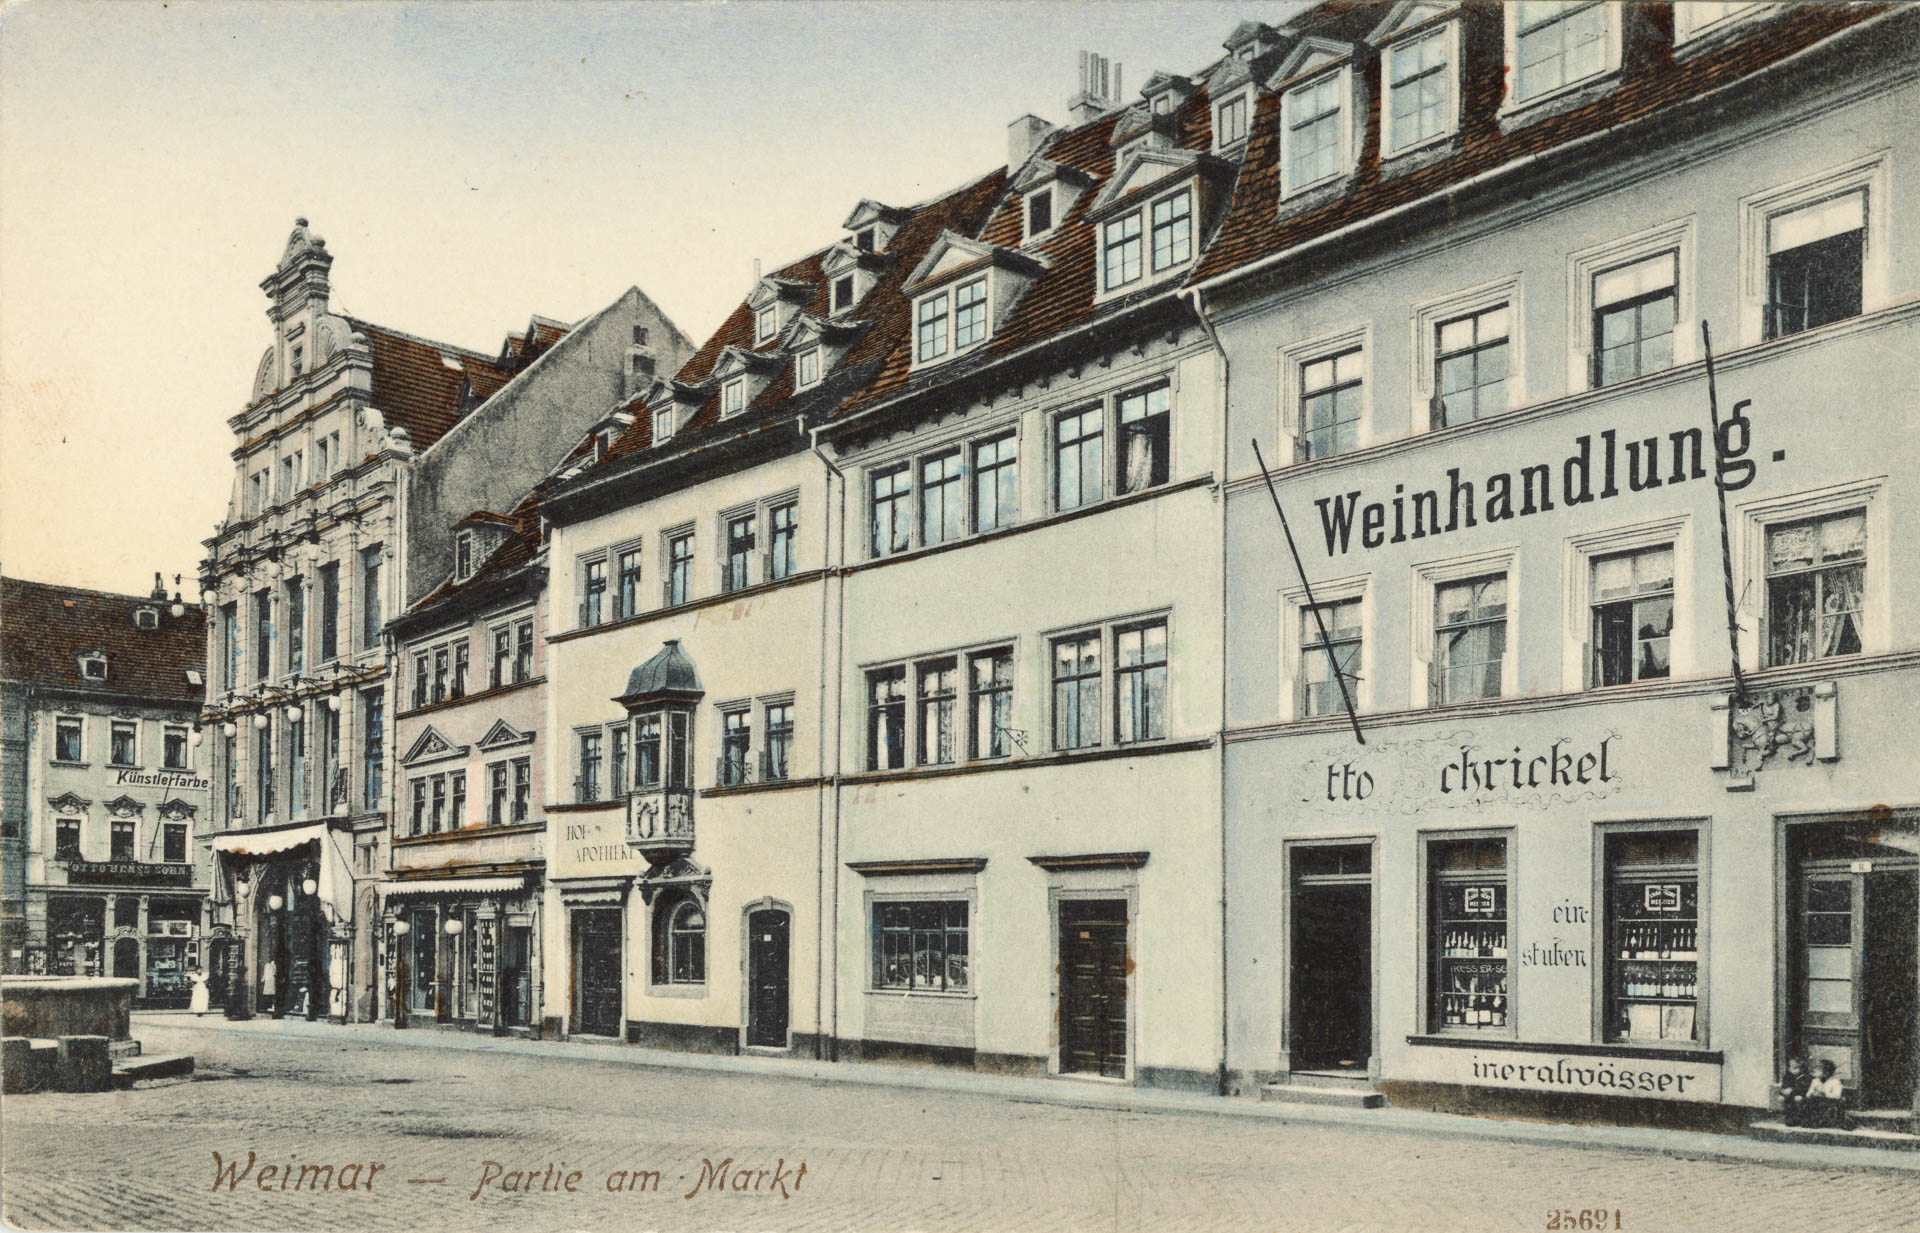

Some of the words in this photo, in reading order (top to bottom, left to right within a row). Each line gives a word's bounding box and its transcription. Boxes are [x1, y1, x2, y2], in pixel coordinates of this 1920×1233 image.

[1315, 399, 1786, 557] Weinhandlung.
[116, 769, 209, 789] Künstlerfarbe
[71, 864, 106, 873] OTTO
